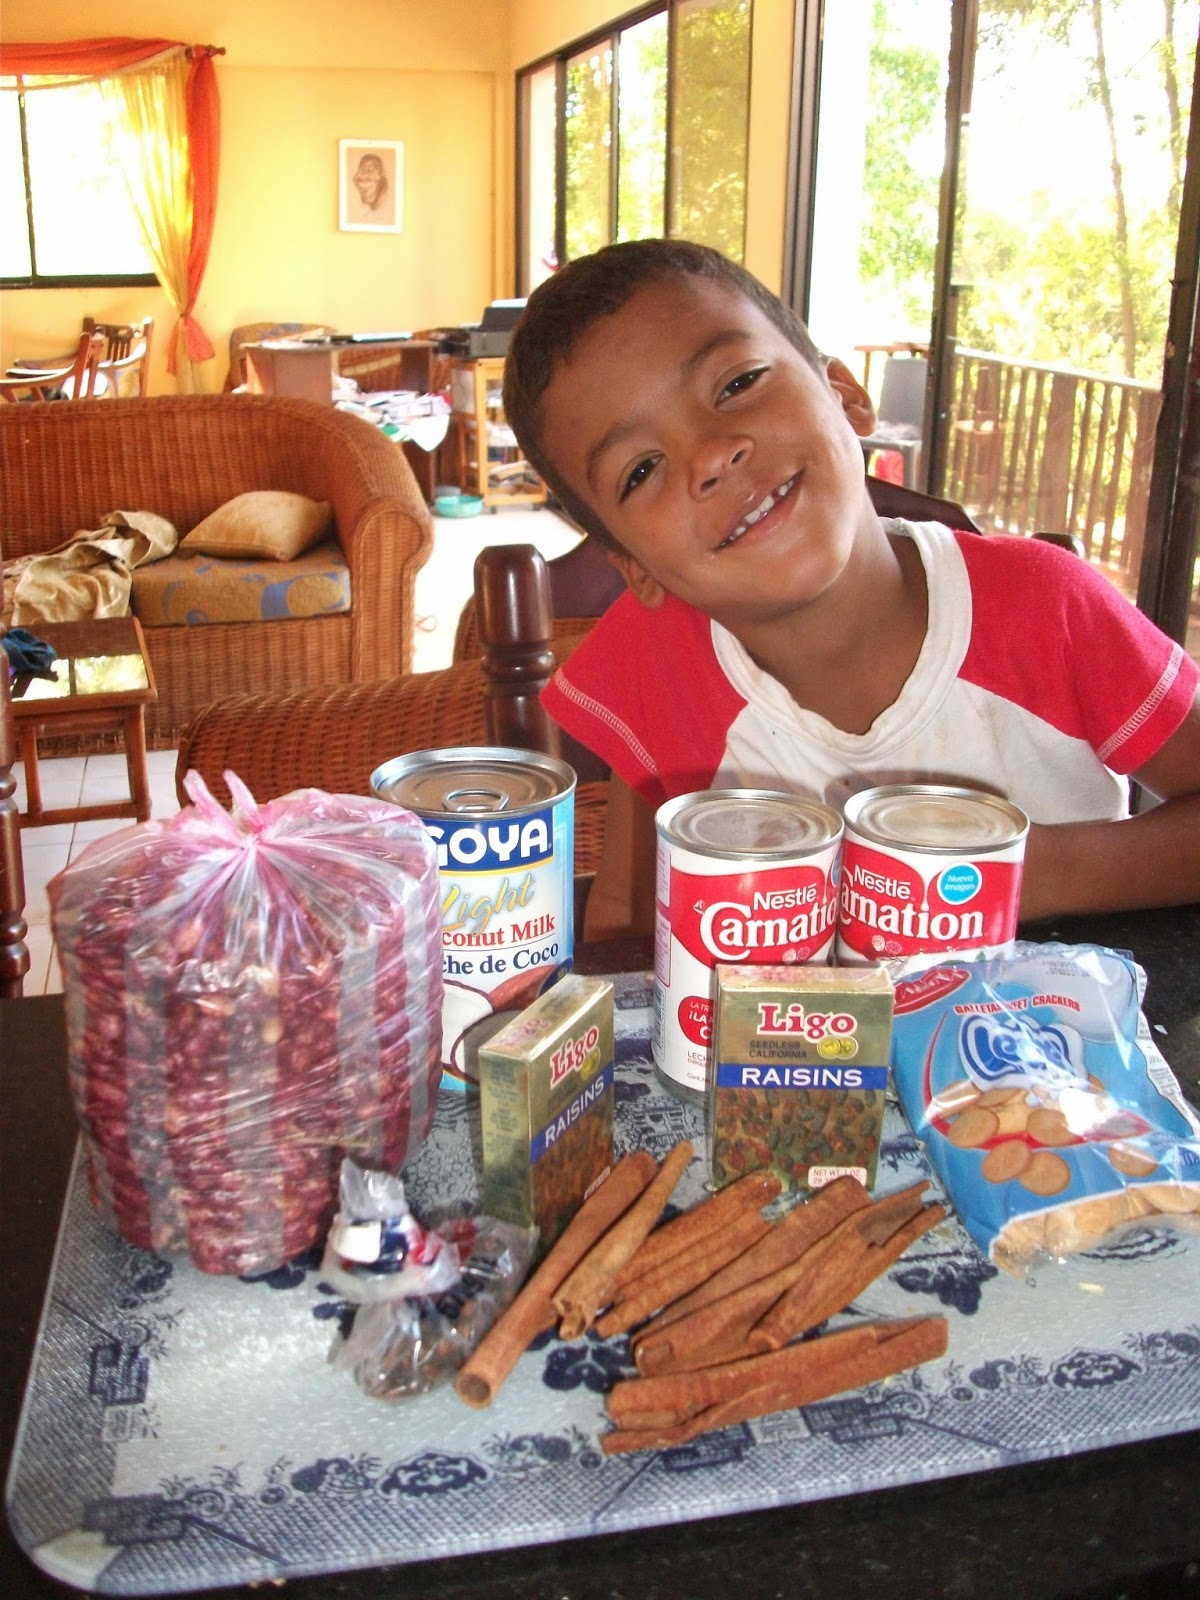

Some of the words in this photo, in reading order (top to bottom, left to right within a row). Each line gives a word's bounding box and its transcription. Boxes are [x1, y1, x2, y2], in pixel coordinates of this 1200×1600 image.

[424, 818, 548, 867] GOYA
[753, 883, 819, 911] Nestlé
[853, 864, 912, 900] Nestlé
[442, 873, 536, 937] Light
[442, 927, 505, 947] conut
[511, 913, 556, 943] Milk
[699, 897, 837, 962] Carnatio
[479, 954, 507, 974] de
[513, 942, 559, 970] Coco
[1031, 994, 1081, 1013] CRACKERS
[757, 1002, 858, 1044] Ligo
[550, 1025, 600, 1091] Ligo
[748, 1049, 808, 1059] CALIFORNIA
[749, 1040, 801, 1050] SEEDLESS
[741, 1066, 863, 1087] RAISINS
[544, 1075, 605, 1148] RAISINS
